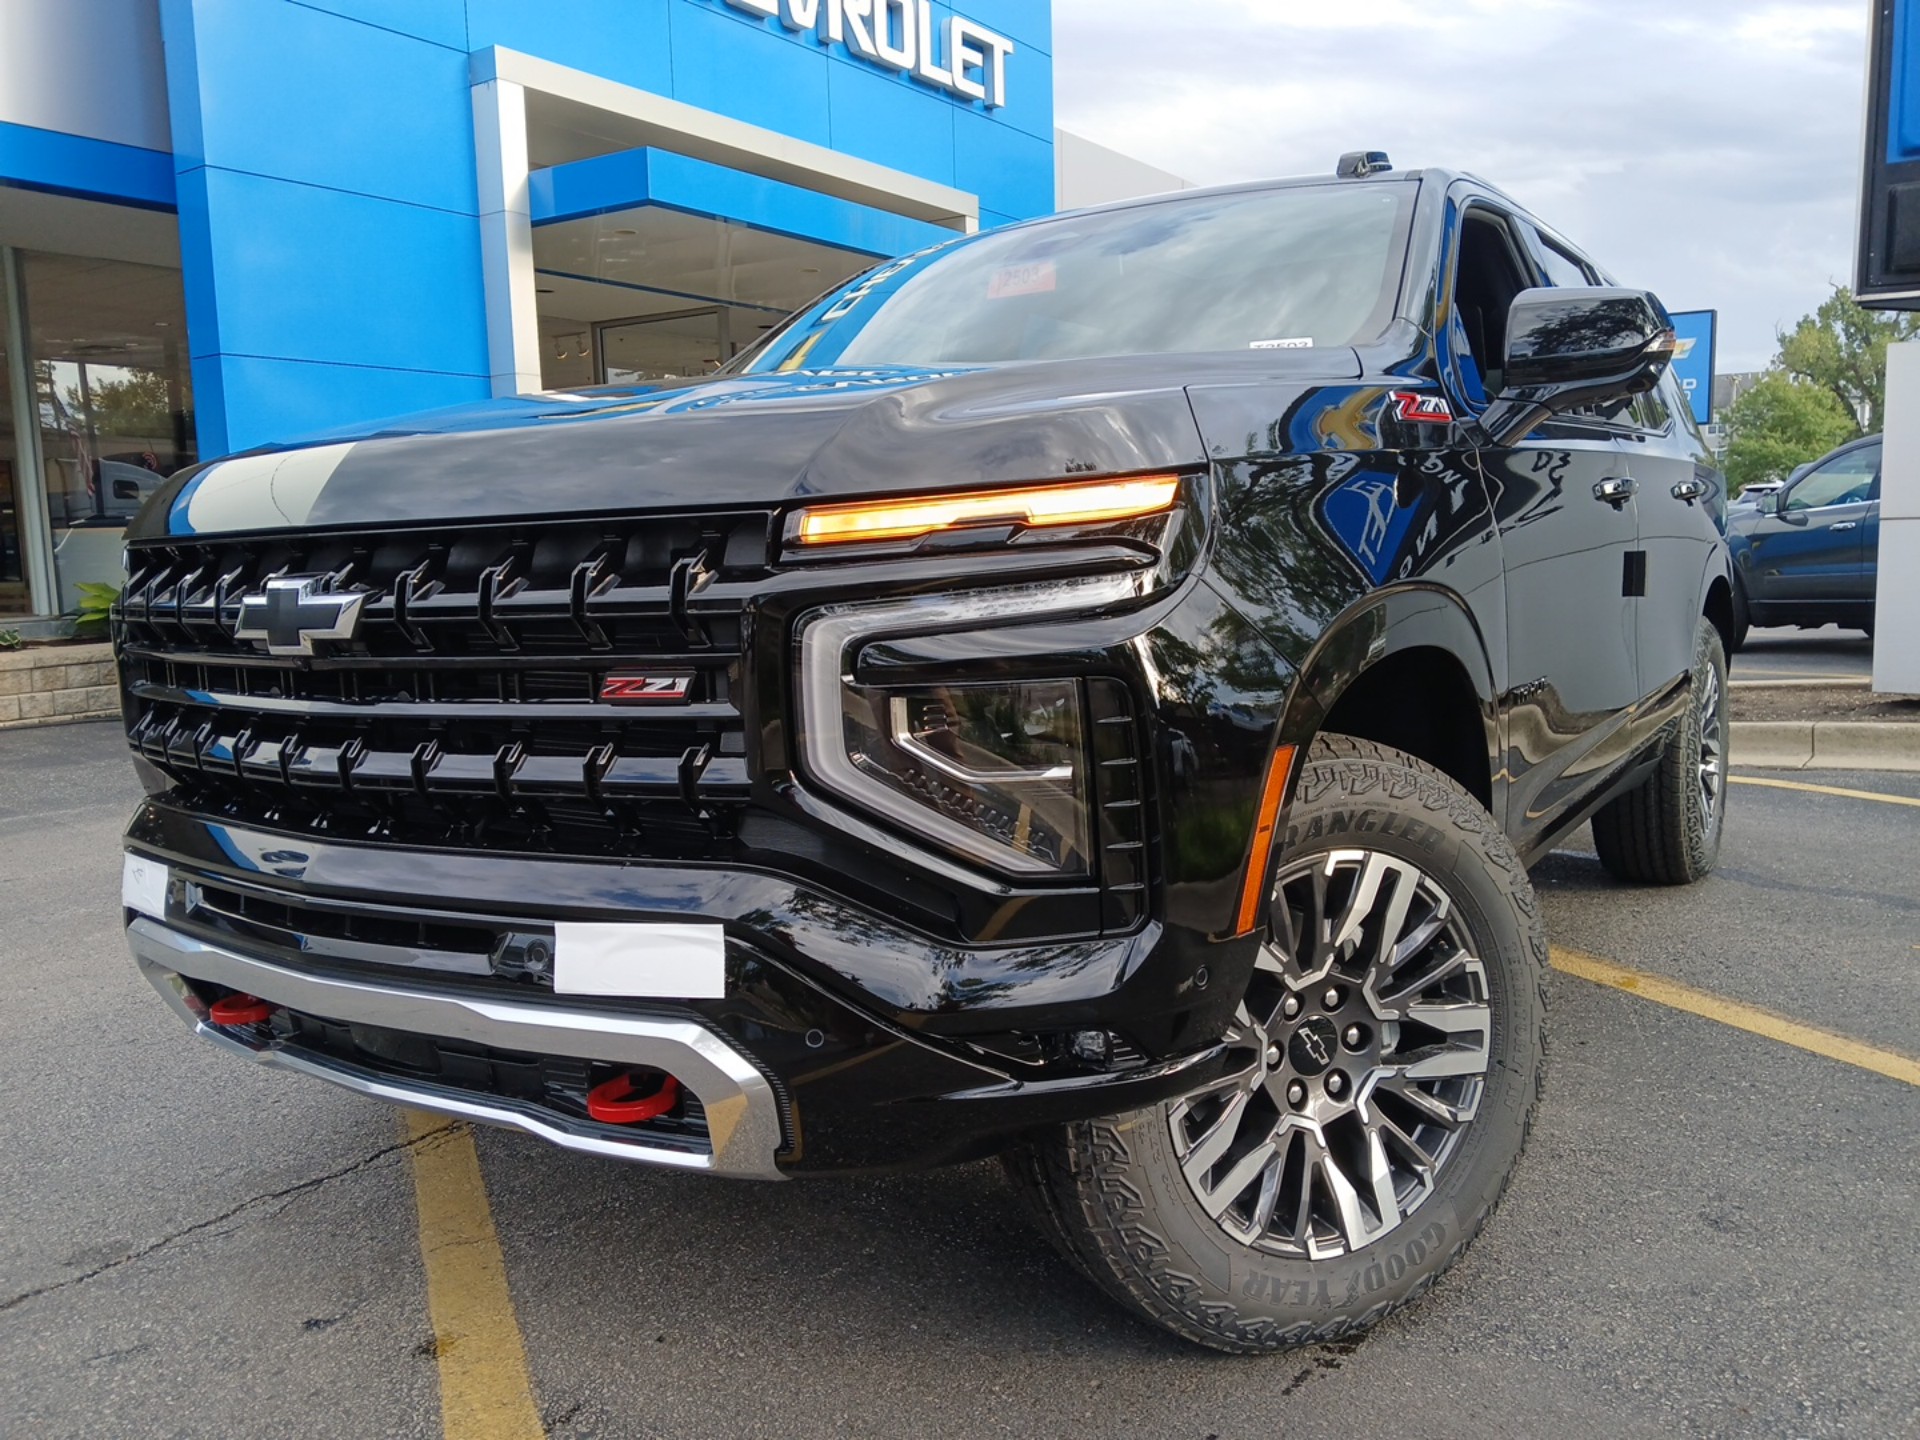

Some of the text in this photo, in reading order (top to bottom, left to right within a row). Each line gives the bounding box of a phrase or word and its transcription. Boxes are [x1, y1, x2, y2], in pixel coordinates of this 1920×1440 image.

[724, 0, 1014, 108] ROLET
[1386, 389, 1453, 423] Z71
[600, 676, 692, 699] Z71
